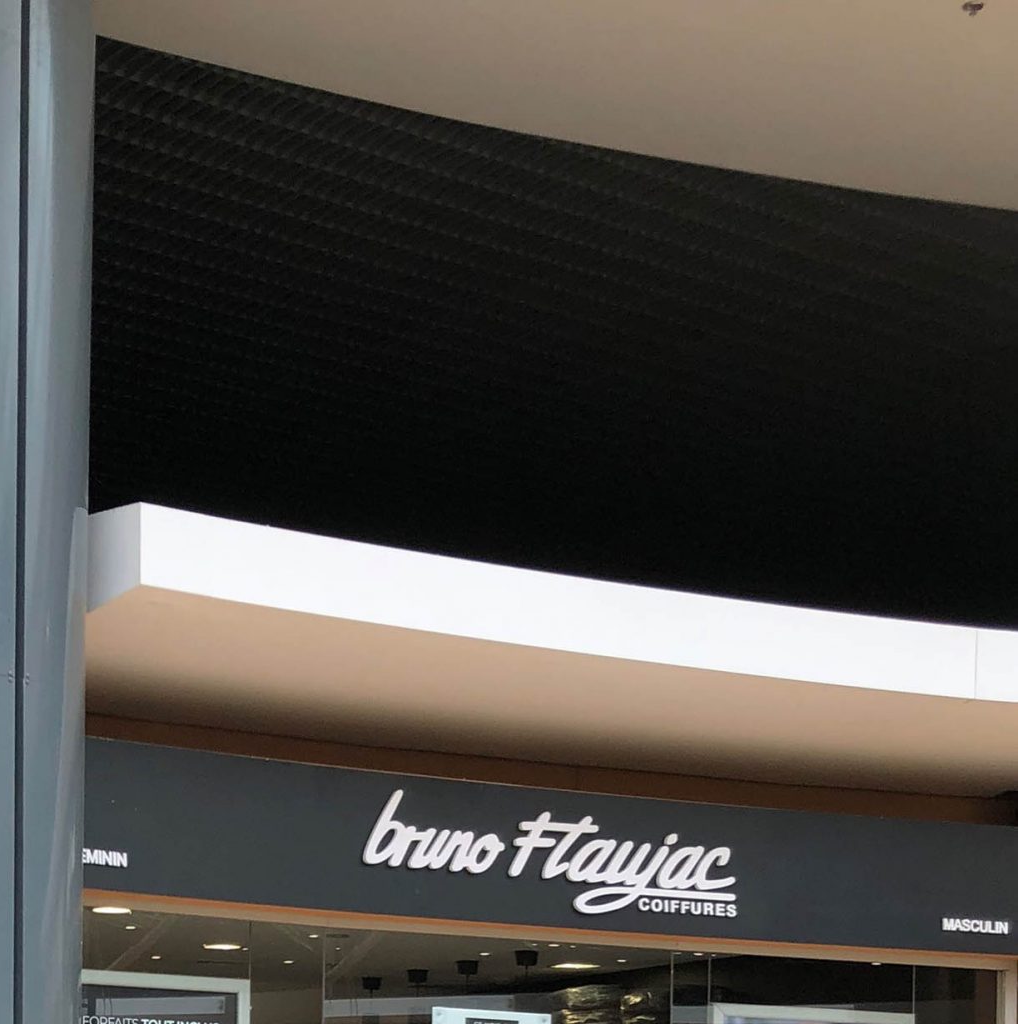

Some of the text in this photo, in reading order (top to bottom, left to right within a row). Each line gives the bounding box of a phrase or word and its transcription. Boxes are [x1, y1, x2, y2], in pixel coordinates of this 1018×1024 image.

[362, 789, 736, 914] bruno Flaujac
[638, 897, 738, 919] COIFFURES
[942, 917, 1009, 935] MASCULIN
